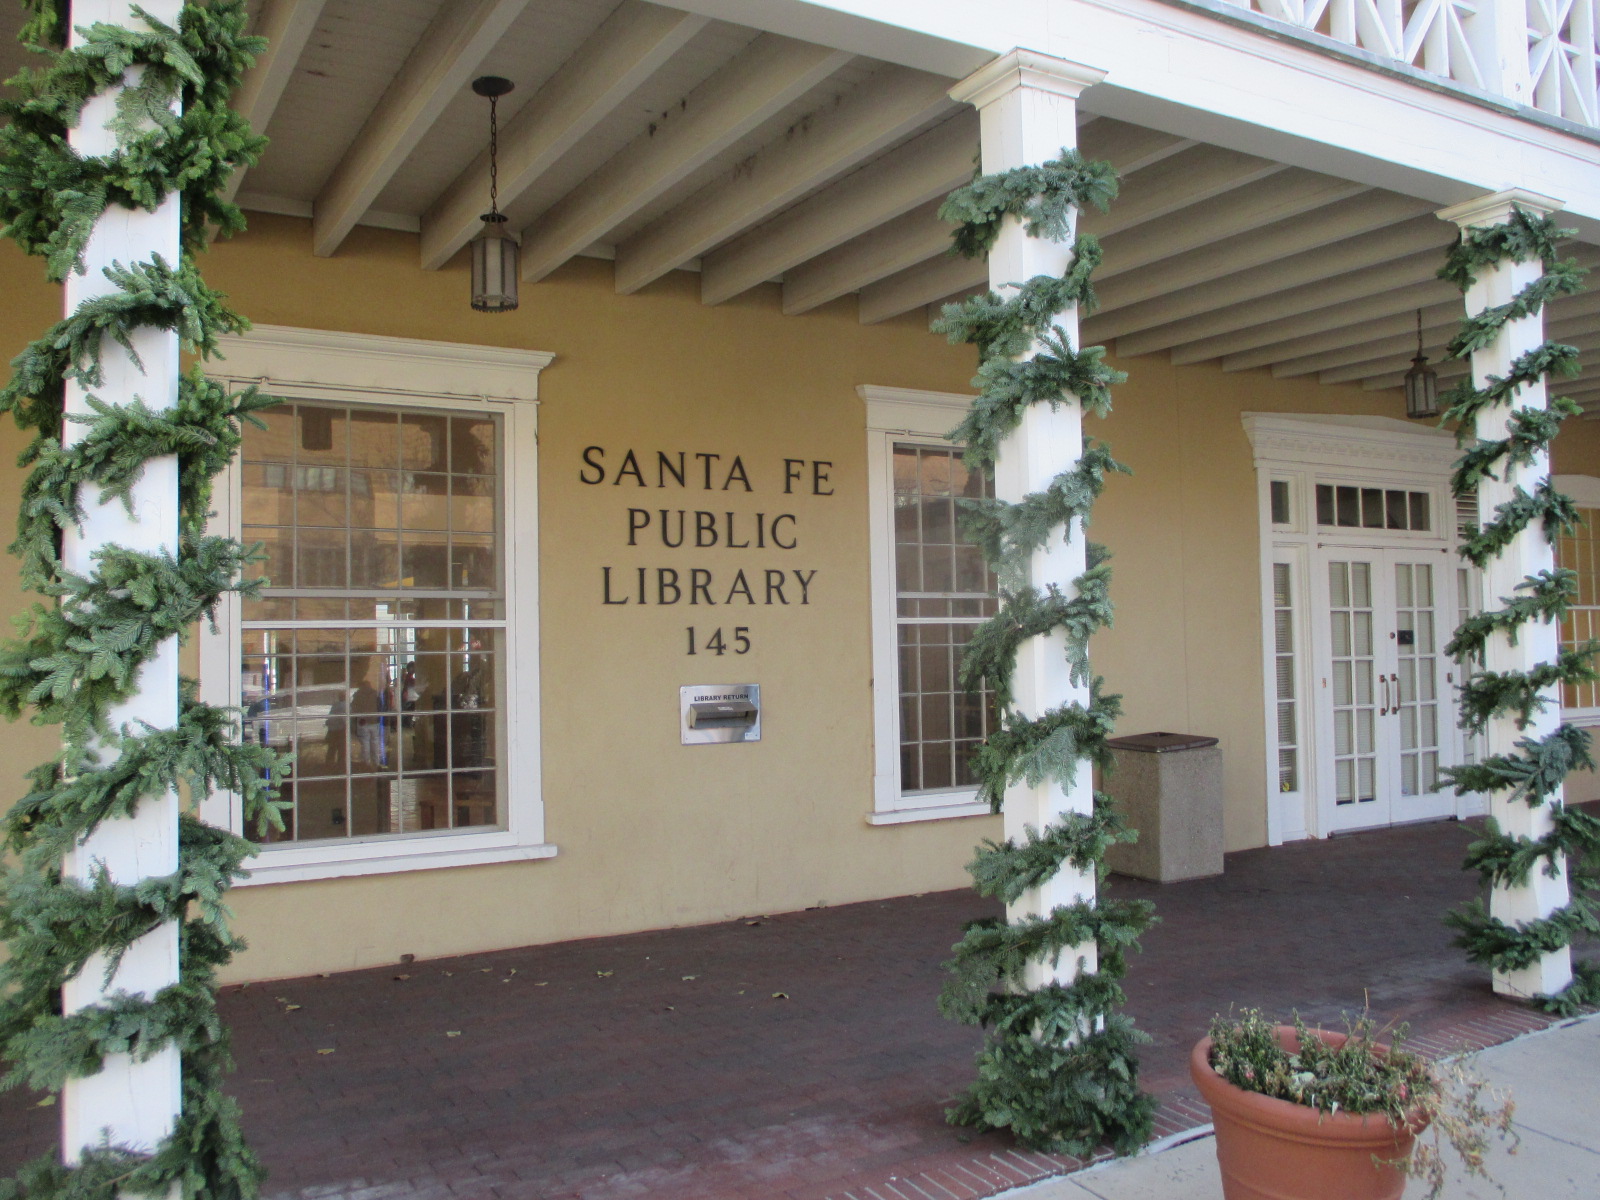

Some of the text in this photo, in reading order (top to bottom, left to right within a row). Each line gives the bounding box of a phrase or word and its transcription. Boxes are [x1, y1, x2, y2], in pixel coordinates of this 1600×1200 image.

[580, 446, 834, 496] SANTA FE
[627, 508, 797, 550] PUBLIC
[602, 567, 818, 605] LIBRARY
[686, 626, 750, 655] 145
